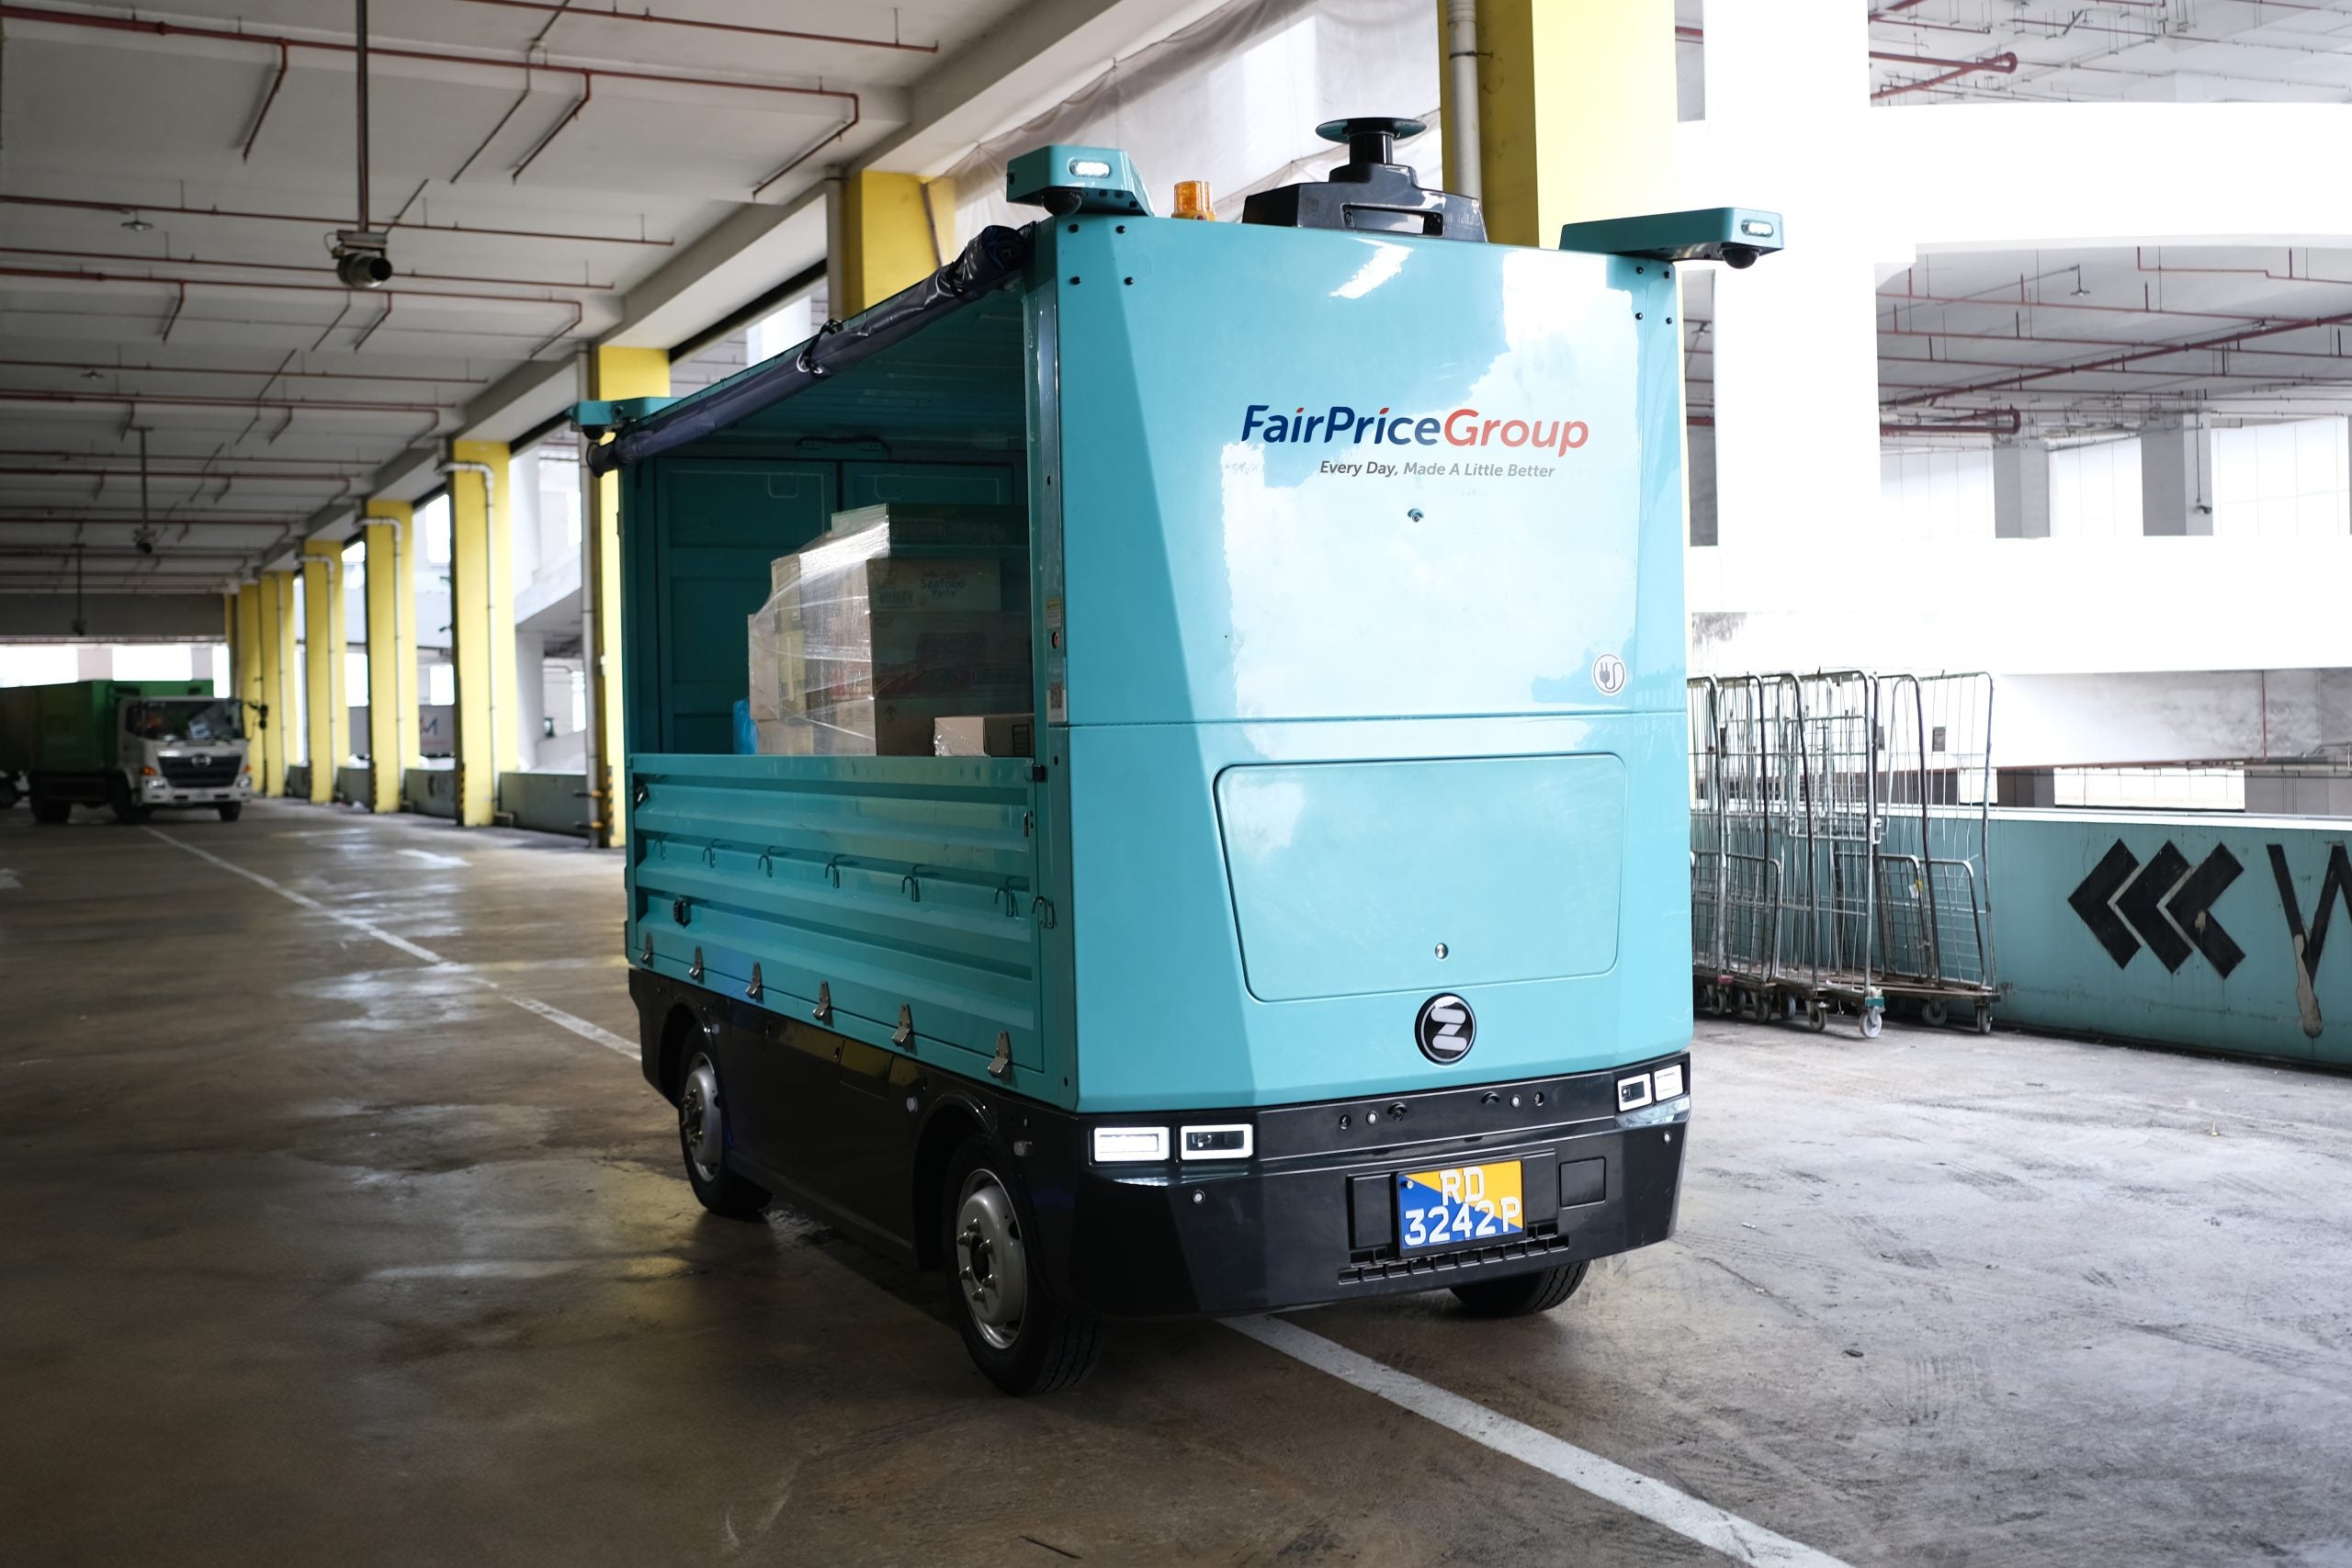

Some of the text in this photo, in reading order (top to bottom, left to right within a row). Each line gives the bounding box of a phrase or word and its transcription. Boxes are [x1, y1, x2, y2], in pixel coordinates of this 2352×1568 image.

[1240, 404, 1589, 457] FairPriceGroup
[1319, 460, 1555, 479] Every Day, Made A Little Better
[920, 578, 966, 589] Seafood
[1439, 1167, 1486, 1206] RD
[1404, 1196, 1521, 1246] 3242P
